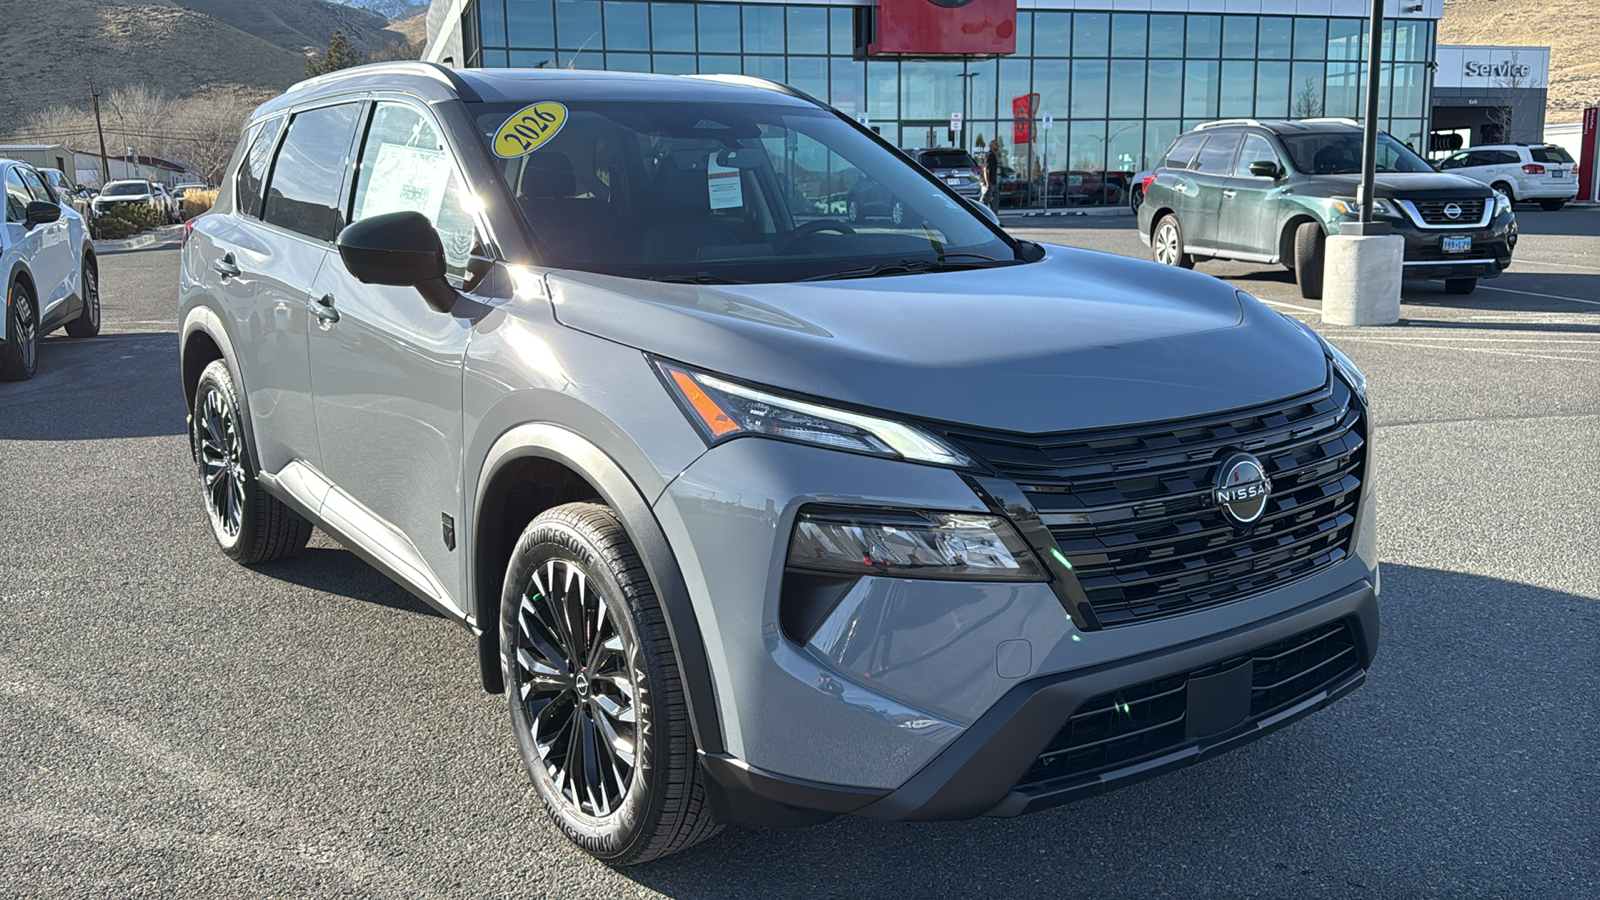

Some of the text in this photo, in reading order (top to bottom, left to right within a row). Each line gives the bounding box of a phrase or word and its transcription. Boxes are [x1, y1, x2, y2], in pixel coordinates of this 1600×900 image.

[1464, 60, 1530, 77] Service
[504, 106, 557, 151] 2026
[1218, 478, 1271, 502] NISSAN
[523, 527, 594, 568] BRIDGESTONE
[635, 668, 652, 770] ALENZA
[543, 797, 615, 852] BRIDGESTONE
